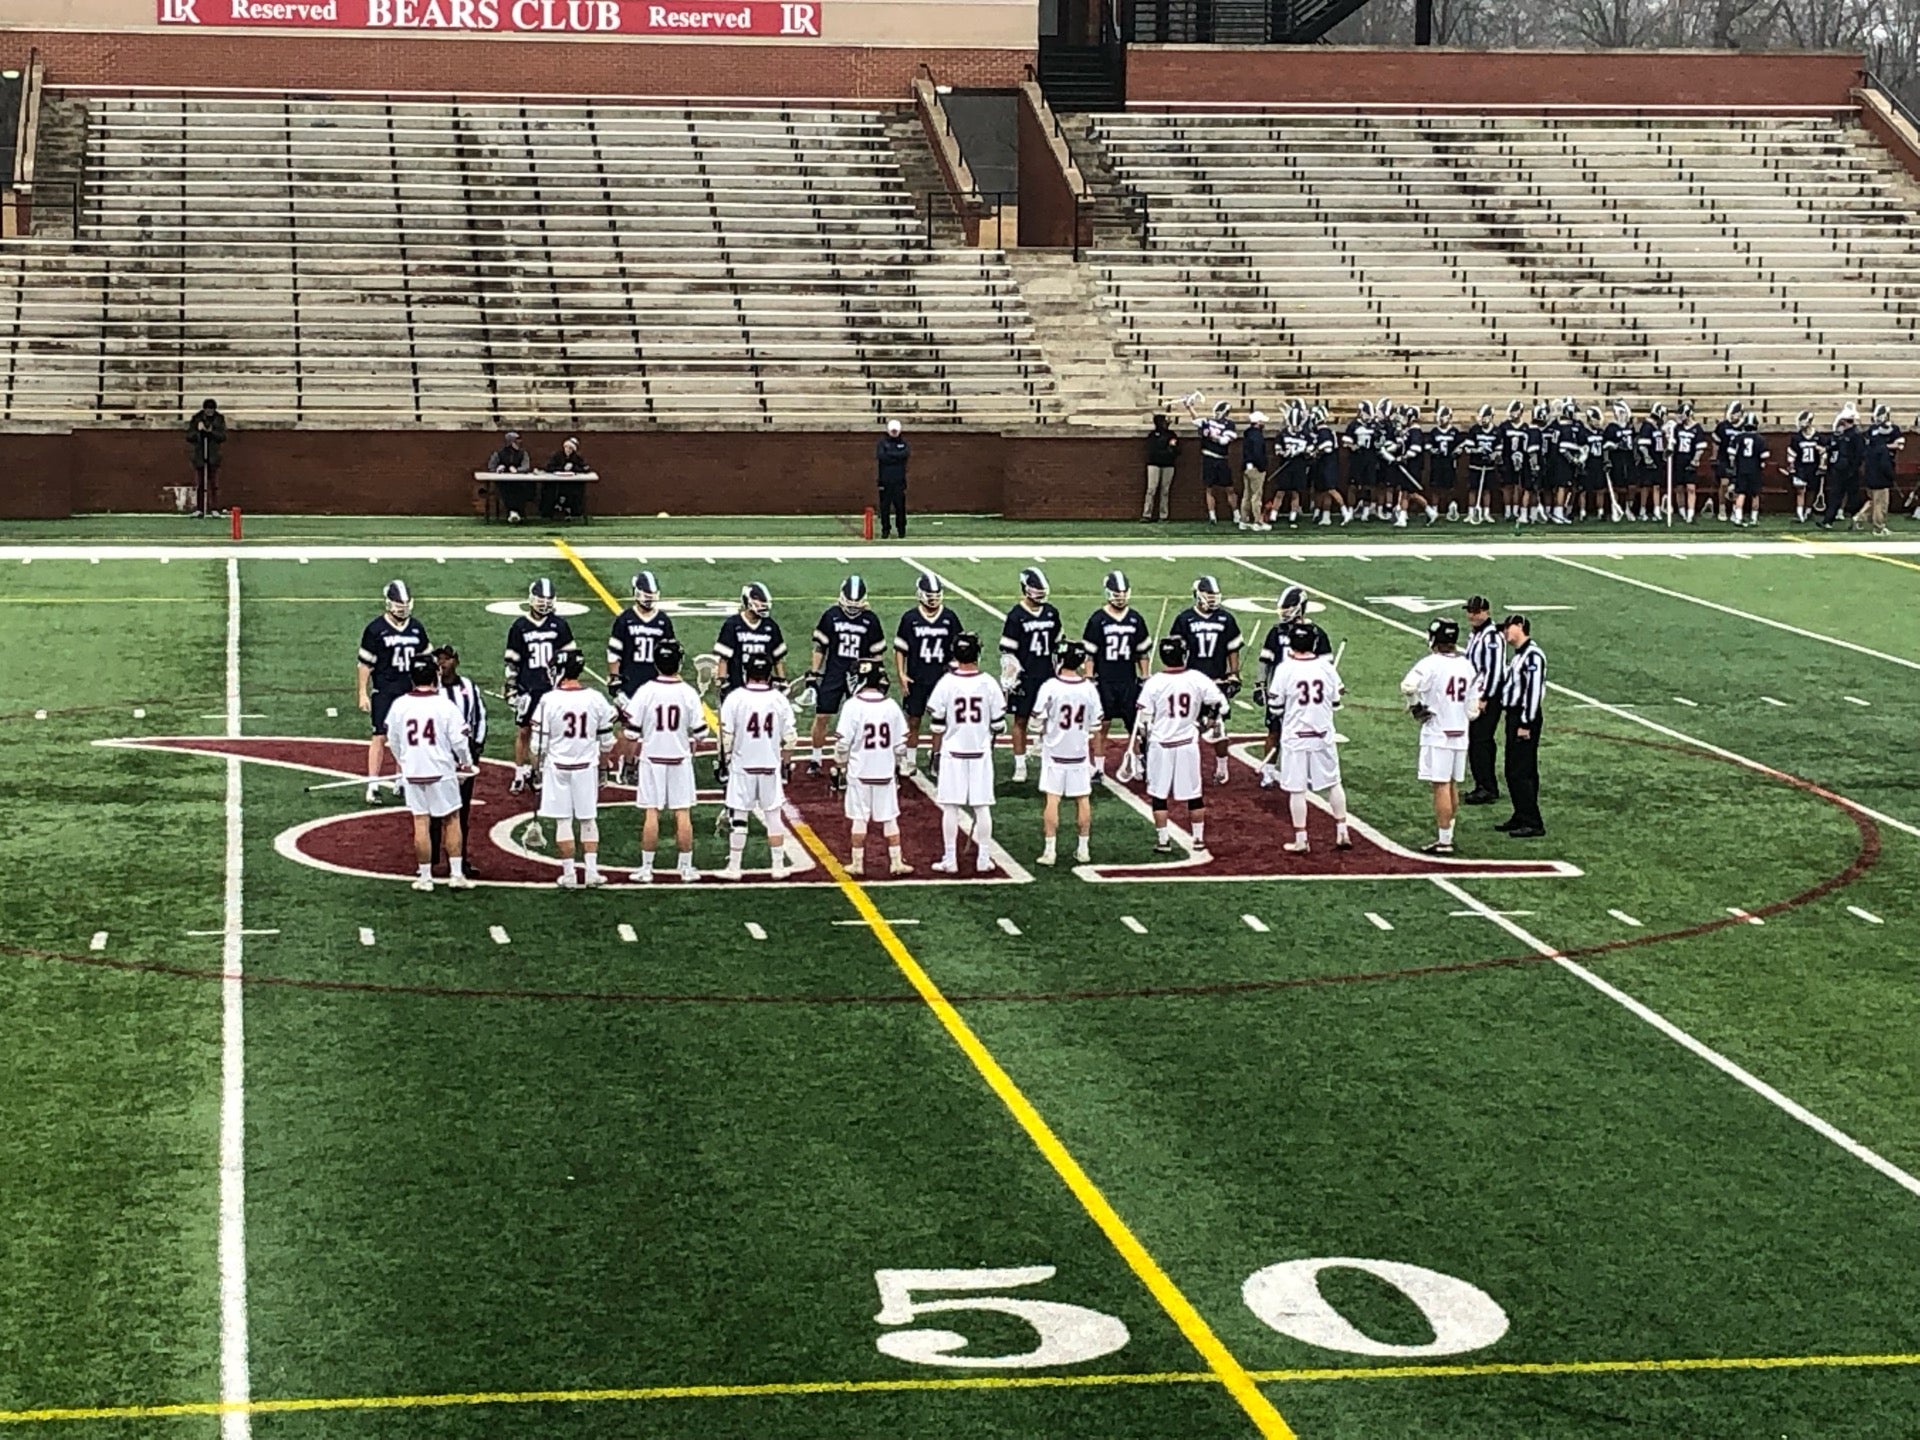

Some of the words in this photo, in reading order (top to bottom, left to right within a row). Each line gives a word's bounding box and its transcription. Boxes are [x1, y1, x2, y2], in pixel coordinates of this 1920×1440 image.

[160, 0, 200, 24] LR
[231, 0, 337, 21] Reserved
[366, 0, 499, 29] BEARS
[512, 0, 621, 31] CLUB
[649, 5, 751, 29] Reserved
[780, 3, 818, 35] LR
[528, 642, 553, 669] 30
[634, 637, 655, 663] 31
[838, 633, 861, 659] 22
[920, 638, 945, 664] 44
[1030, 631, 1050, 656] 41
[1106, 635, 1131, 661] 24
[1196, 632, 1219, 658] 17
[1296, 680, 1324, 705] 33
[1445, 676, 1467, 701] 42
[655, 705, 681, 731] 10
[955, 697, 982, 723] 25
[1059, 704, 1086, 730] 34
[1167, 693, 1191, 718] 19
[406, 718, 437, 746] 24
[563, 712, 588, 739] 31
[746, 712, 774, 739] 44
[864, 722, 891, 749] 29
[873, 1257, 1510, 1368] 50
